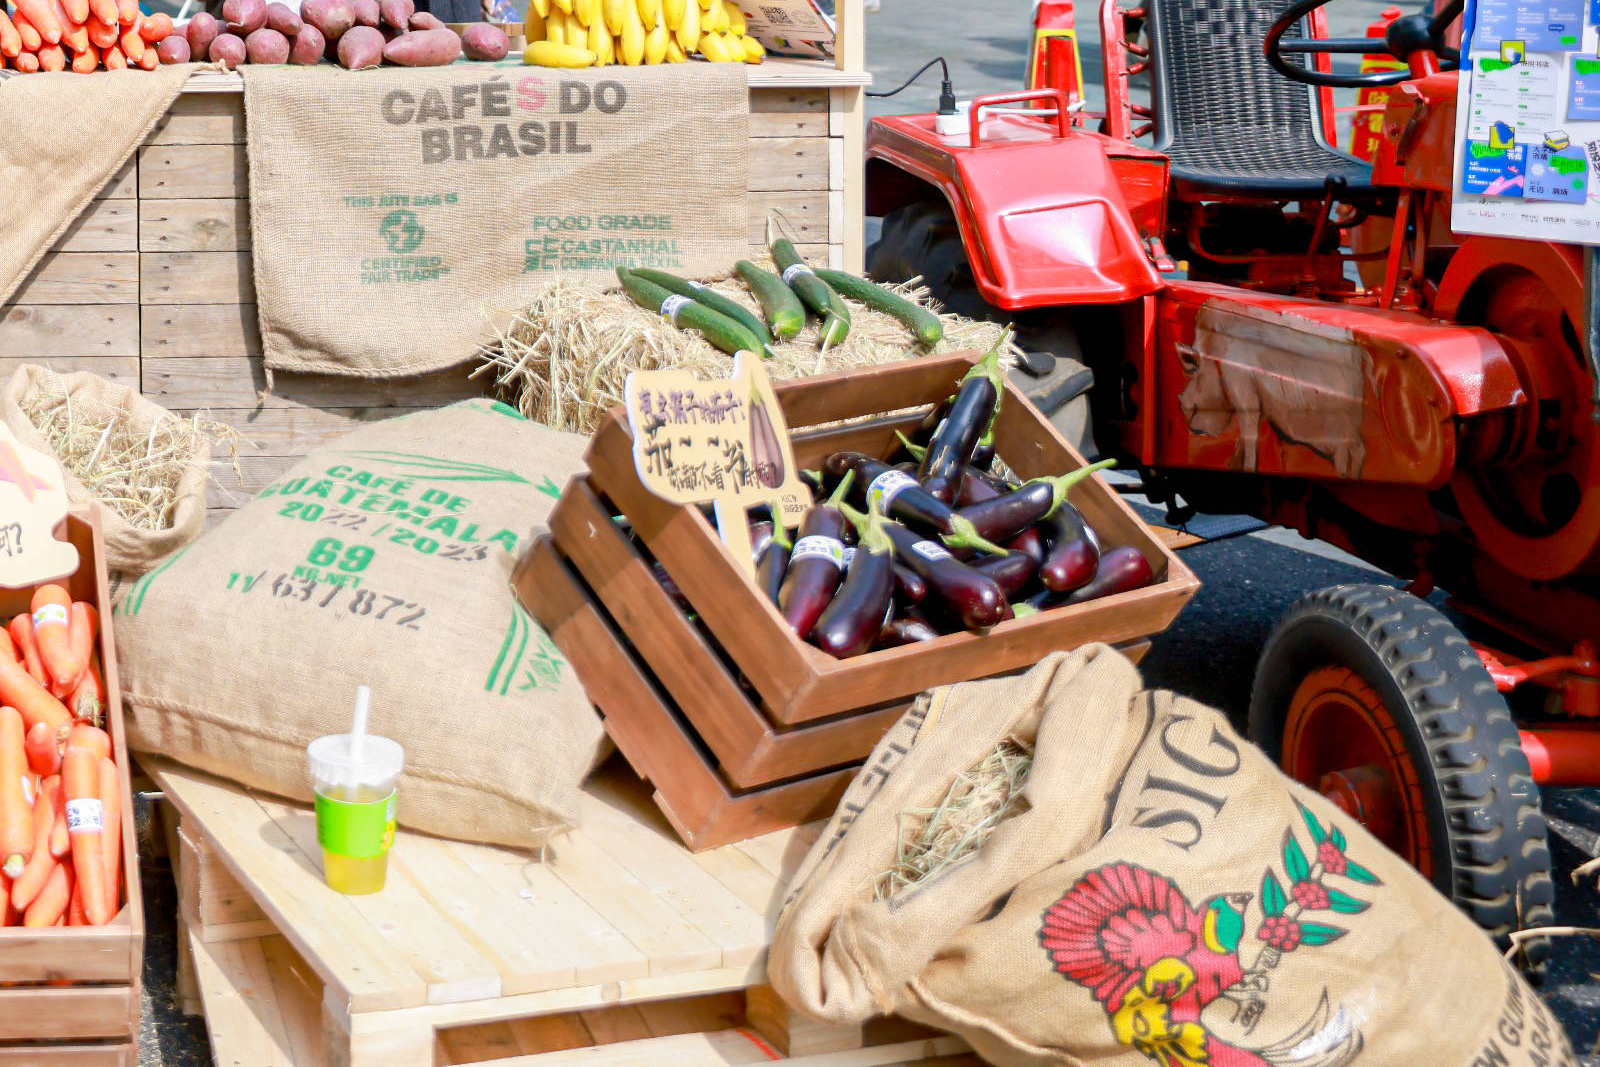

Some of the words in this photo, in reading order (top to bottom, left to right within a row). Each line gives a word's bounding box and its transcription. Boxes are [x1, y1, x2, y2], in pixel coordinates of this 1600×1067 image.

[381, 76, 547, 125] CAFÉS
[560, 80, 627, 115] DO
[421, 121, 592, 164] BRASIL
[534, 215, 592, 232] FOOD
[600, 214, 672, 231] GRADE
[563, 238, 683, 255] CASTANHAL
[256, 477, 518, 553] GUATEMALA
[420, 487, 472, 514] DE
[306, 537, 376, 573] 69
